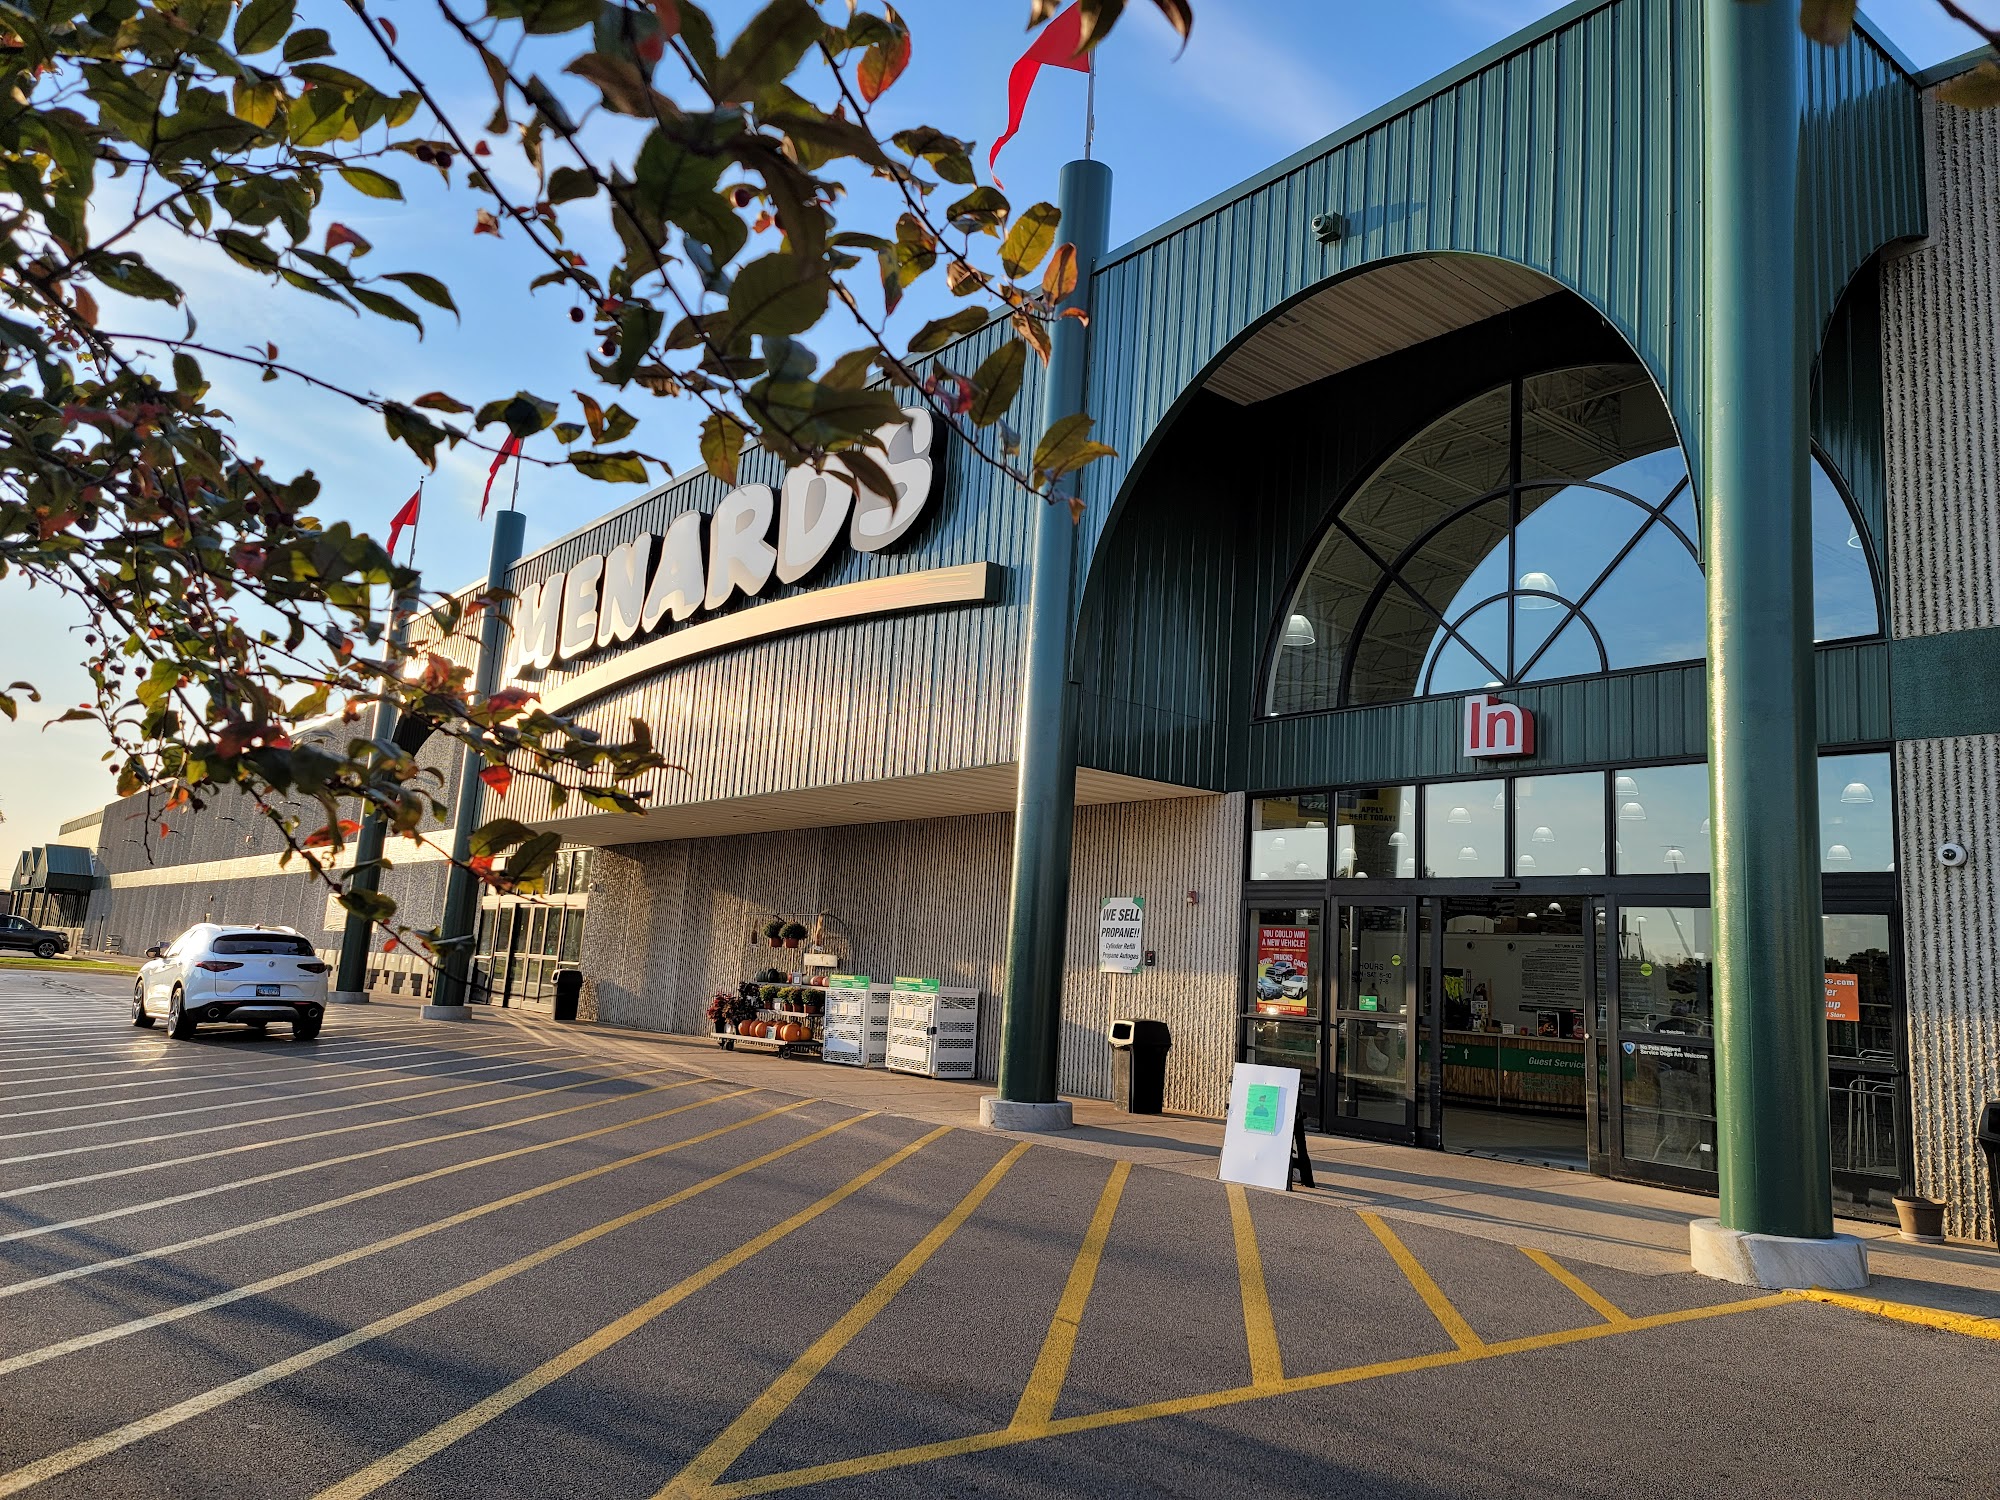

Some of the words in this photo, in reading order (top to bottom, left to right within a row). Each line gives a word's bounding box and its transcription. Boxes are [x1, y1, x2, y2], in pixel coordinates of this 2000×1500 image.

[508, 406, 934, 679] MENARDS
[1470, 702, 1516, 749] In
[1349, 813, 1368, 821] HERE
[1369, 814, 1396, 822] TODAY!
[1103, 909, 1117, 921] WE
[1118, 909, 1140, 921] SELL
[1101, 927, 1140, 938] PROPANE!!
[1263, 929, 1274, 938] YOU
[1274, 930, 1293, 938] COULD
[1293, 930, 1306, 938] WIN
[1261, 938, 1266, 946] A
[1266, 938, 1281, 946] NEW
[1280, 939, 1306, 947] VEHICLE!
[1273, 953, 1293, 961] TRUCKS
[1528, 1056, 1553, 1067] Guest
